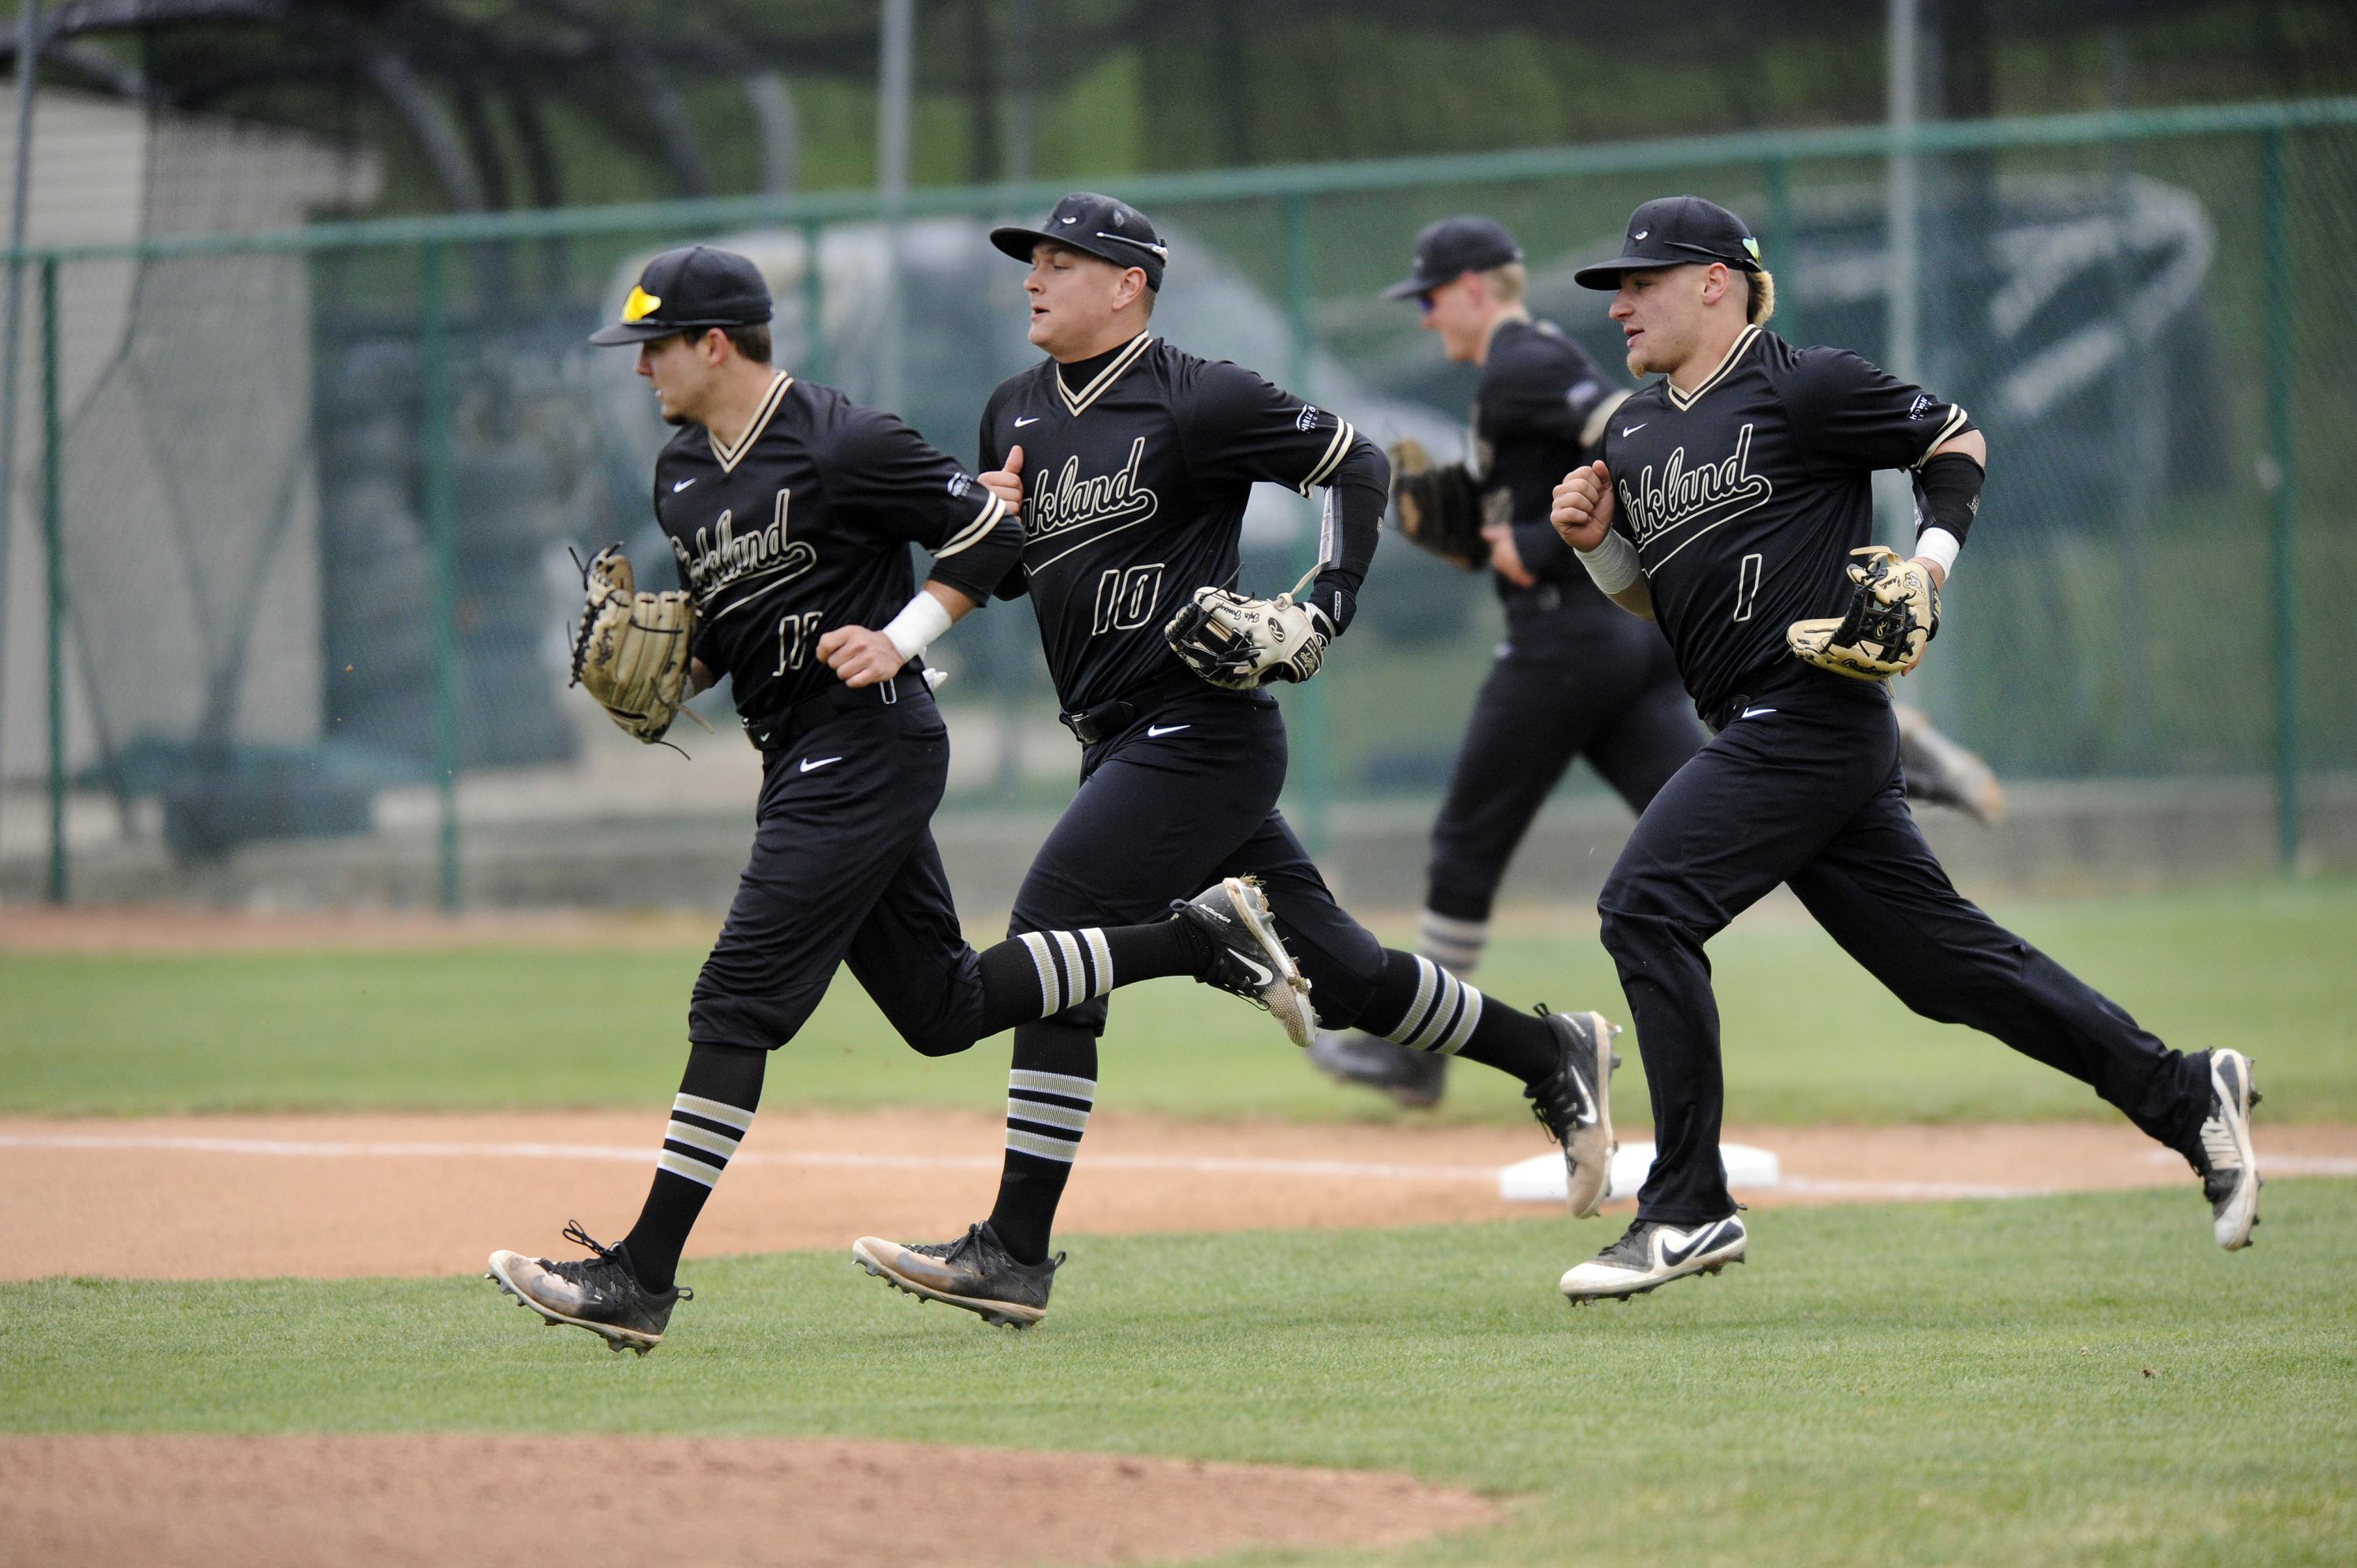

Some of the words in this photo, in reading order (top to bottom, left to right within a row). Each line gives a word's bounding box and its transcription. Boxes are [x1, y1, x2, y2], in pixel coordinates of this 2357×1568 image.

[1021, 437, 1153, 546] akland
[1092, 563, 1165, 636] 10
[1733, 553, 1762, 622] 1
[2200, 1116, 2245, 1170] NIKE
